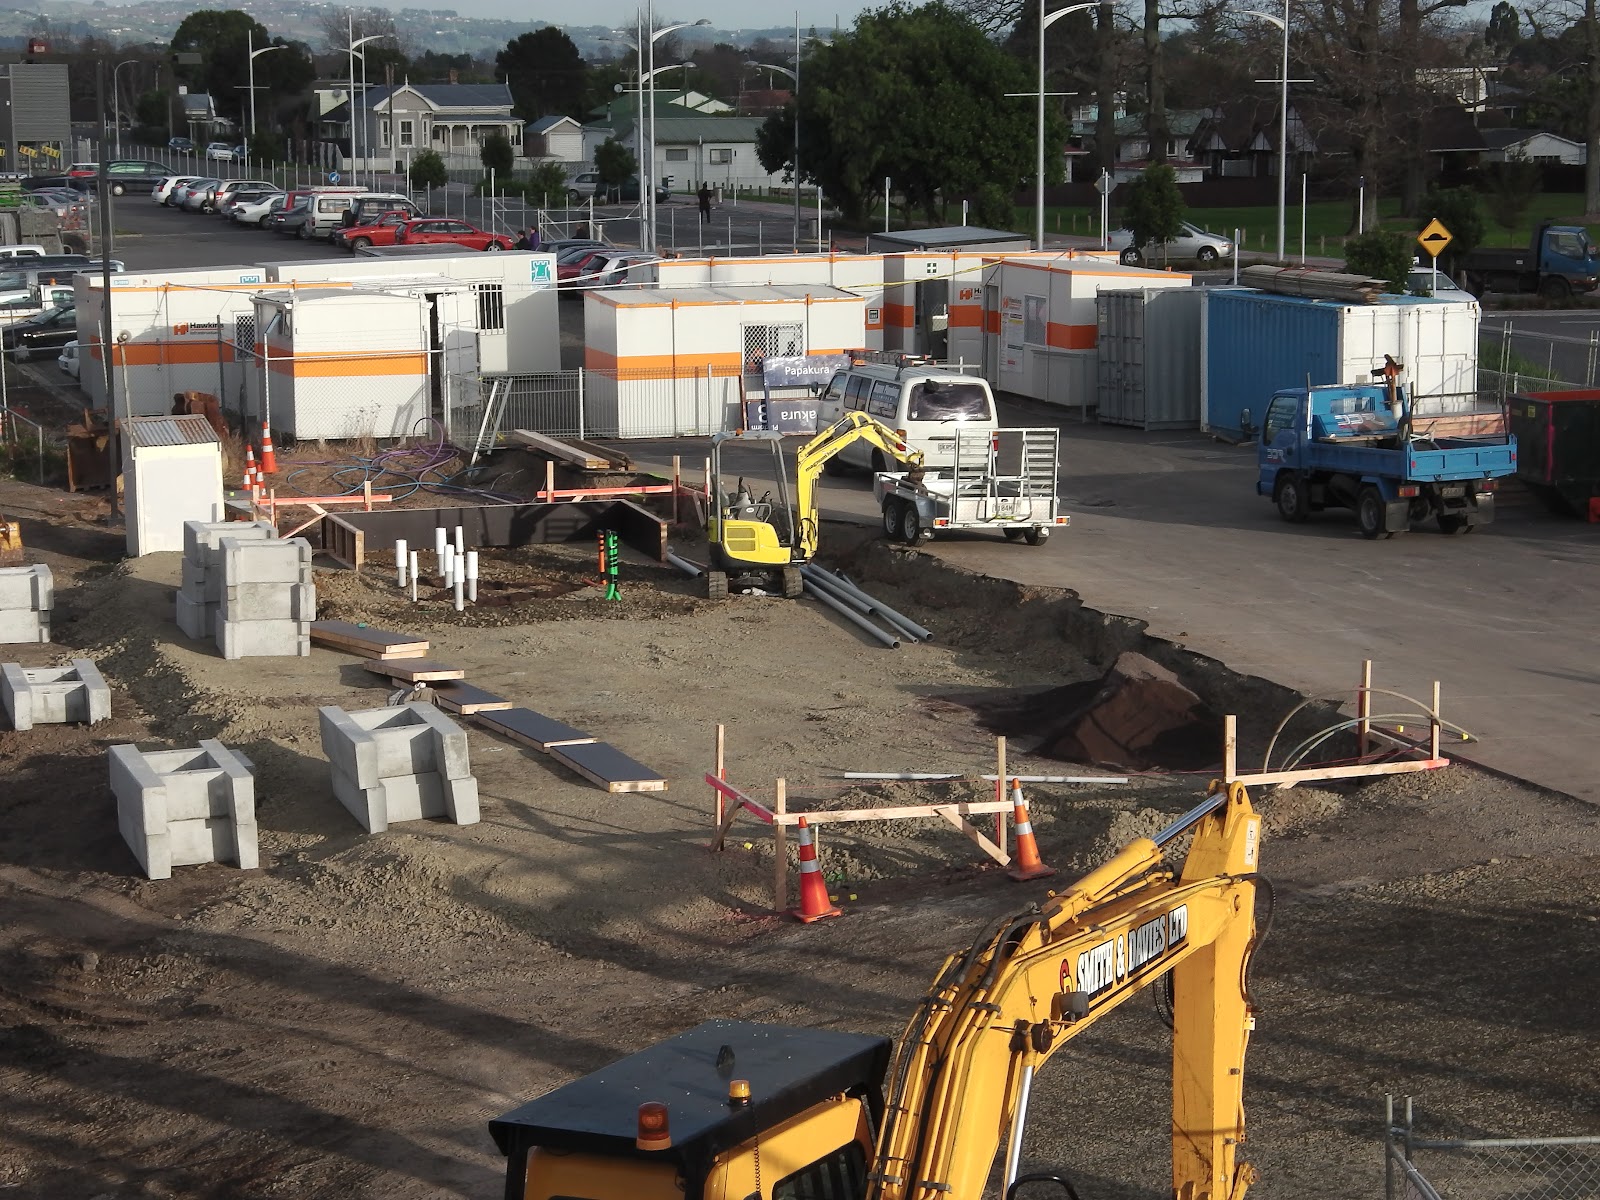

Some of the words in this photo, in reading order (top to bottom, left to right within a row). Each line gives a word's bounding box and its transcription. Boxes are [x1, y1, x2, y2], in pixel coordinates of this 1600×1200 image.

[785, 366, 830, 377] Papakura
[781, 410, 817, 422] akura
[1076, 938, 1114, 999] SMITH
[1116, 934, 1126, 984] &
[1127, 914, 1166, 978] DAVIES
[1168, 904, 1188, 951] LTD
